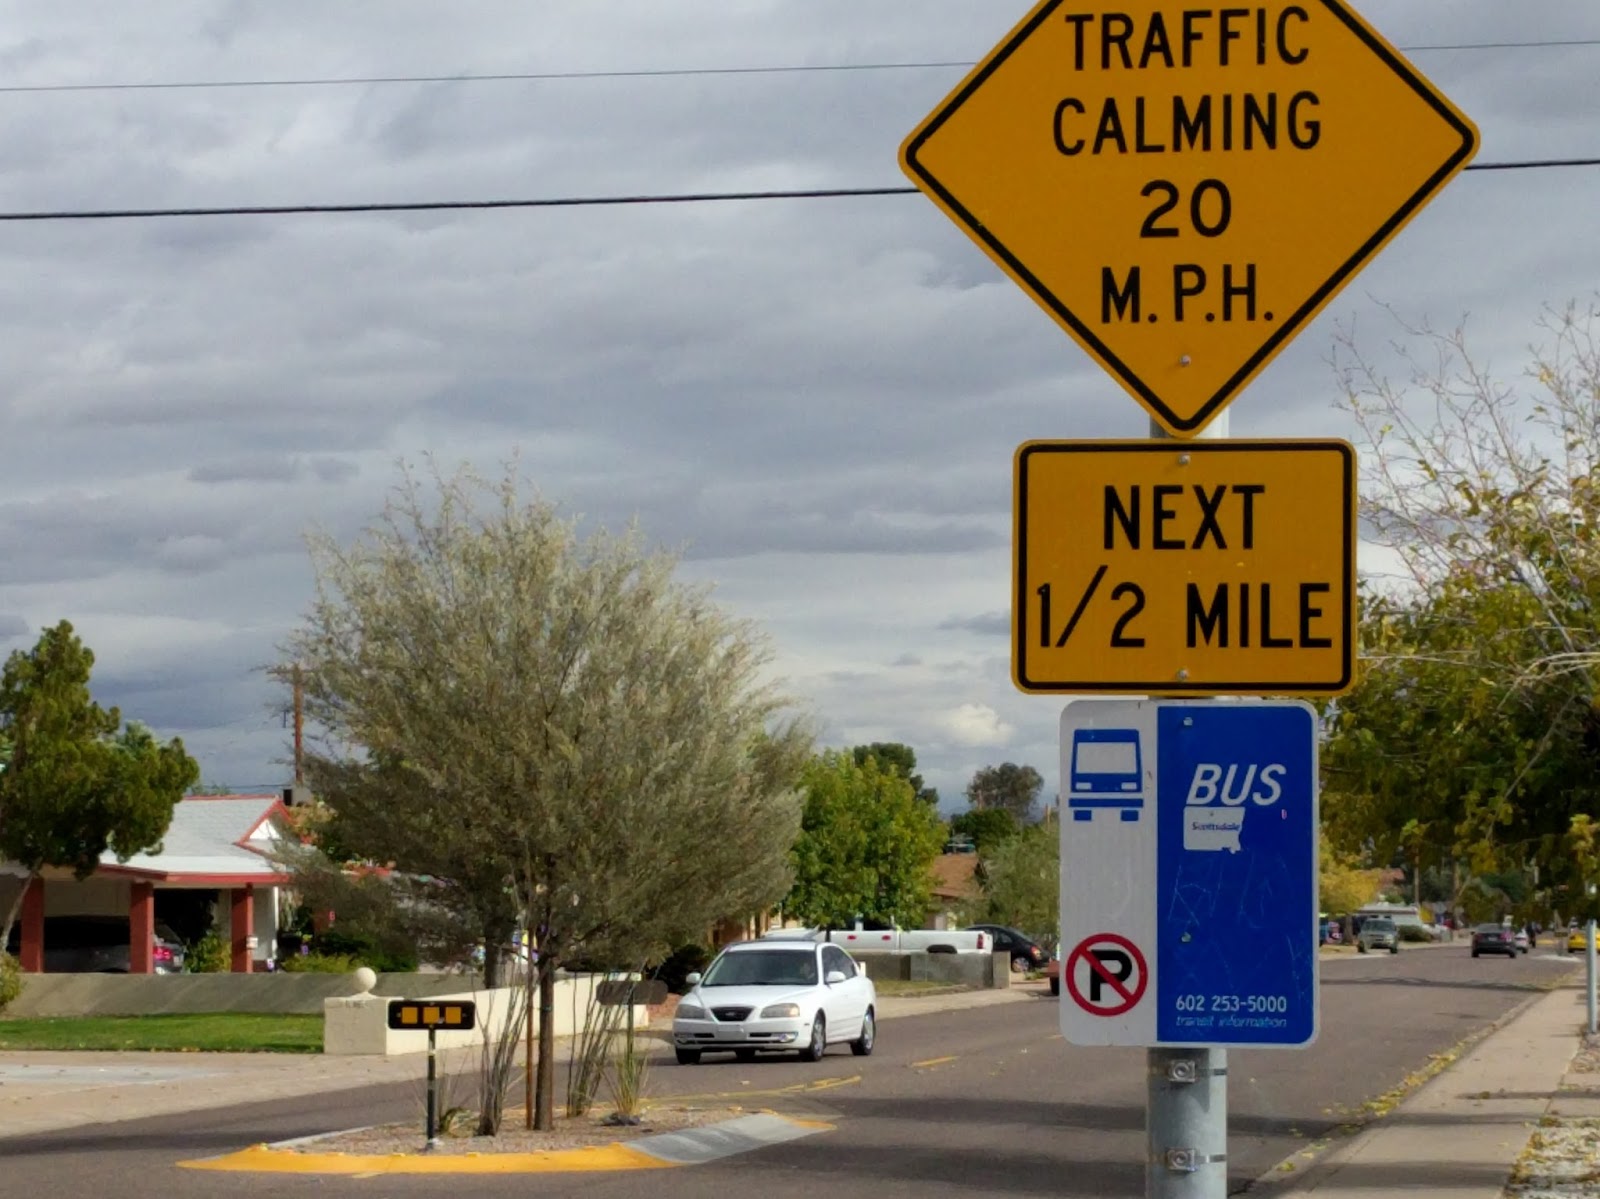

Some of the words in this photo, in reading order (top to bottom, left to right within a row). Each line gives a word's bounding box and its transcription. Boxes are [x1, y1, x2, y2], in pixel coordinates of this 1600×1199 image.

[1065, 6, 1310, 71] TRAFFIC
[1053, 90, 1321, 156] CALMING
[1139, 179, 1232, 238] 20
[1104, 484, 1265, 550] NEXT
[1037, 565, 1146, 648] 1/2
[1186, 582, 1332, 648] MILE
[1185, 763, 1287, 807] BUS
[1090, 949, 1133, 1001] P
[1175, 994, 1206, 1012] 602
[1211, 995, 1287, 1012] 253-5000
